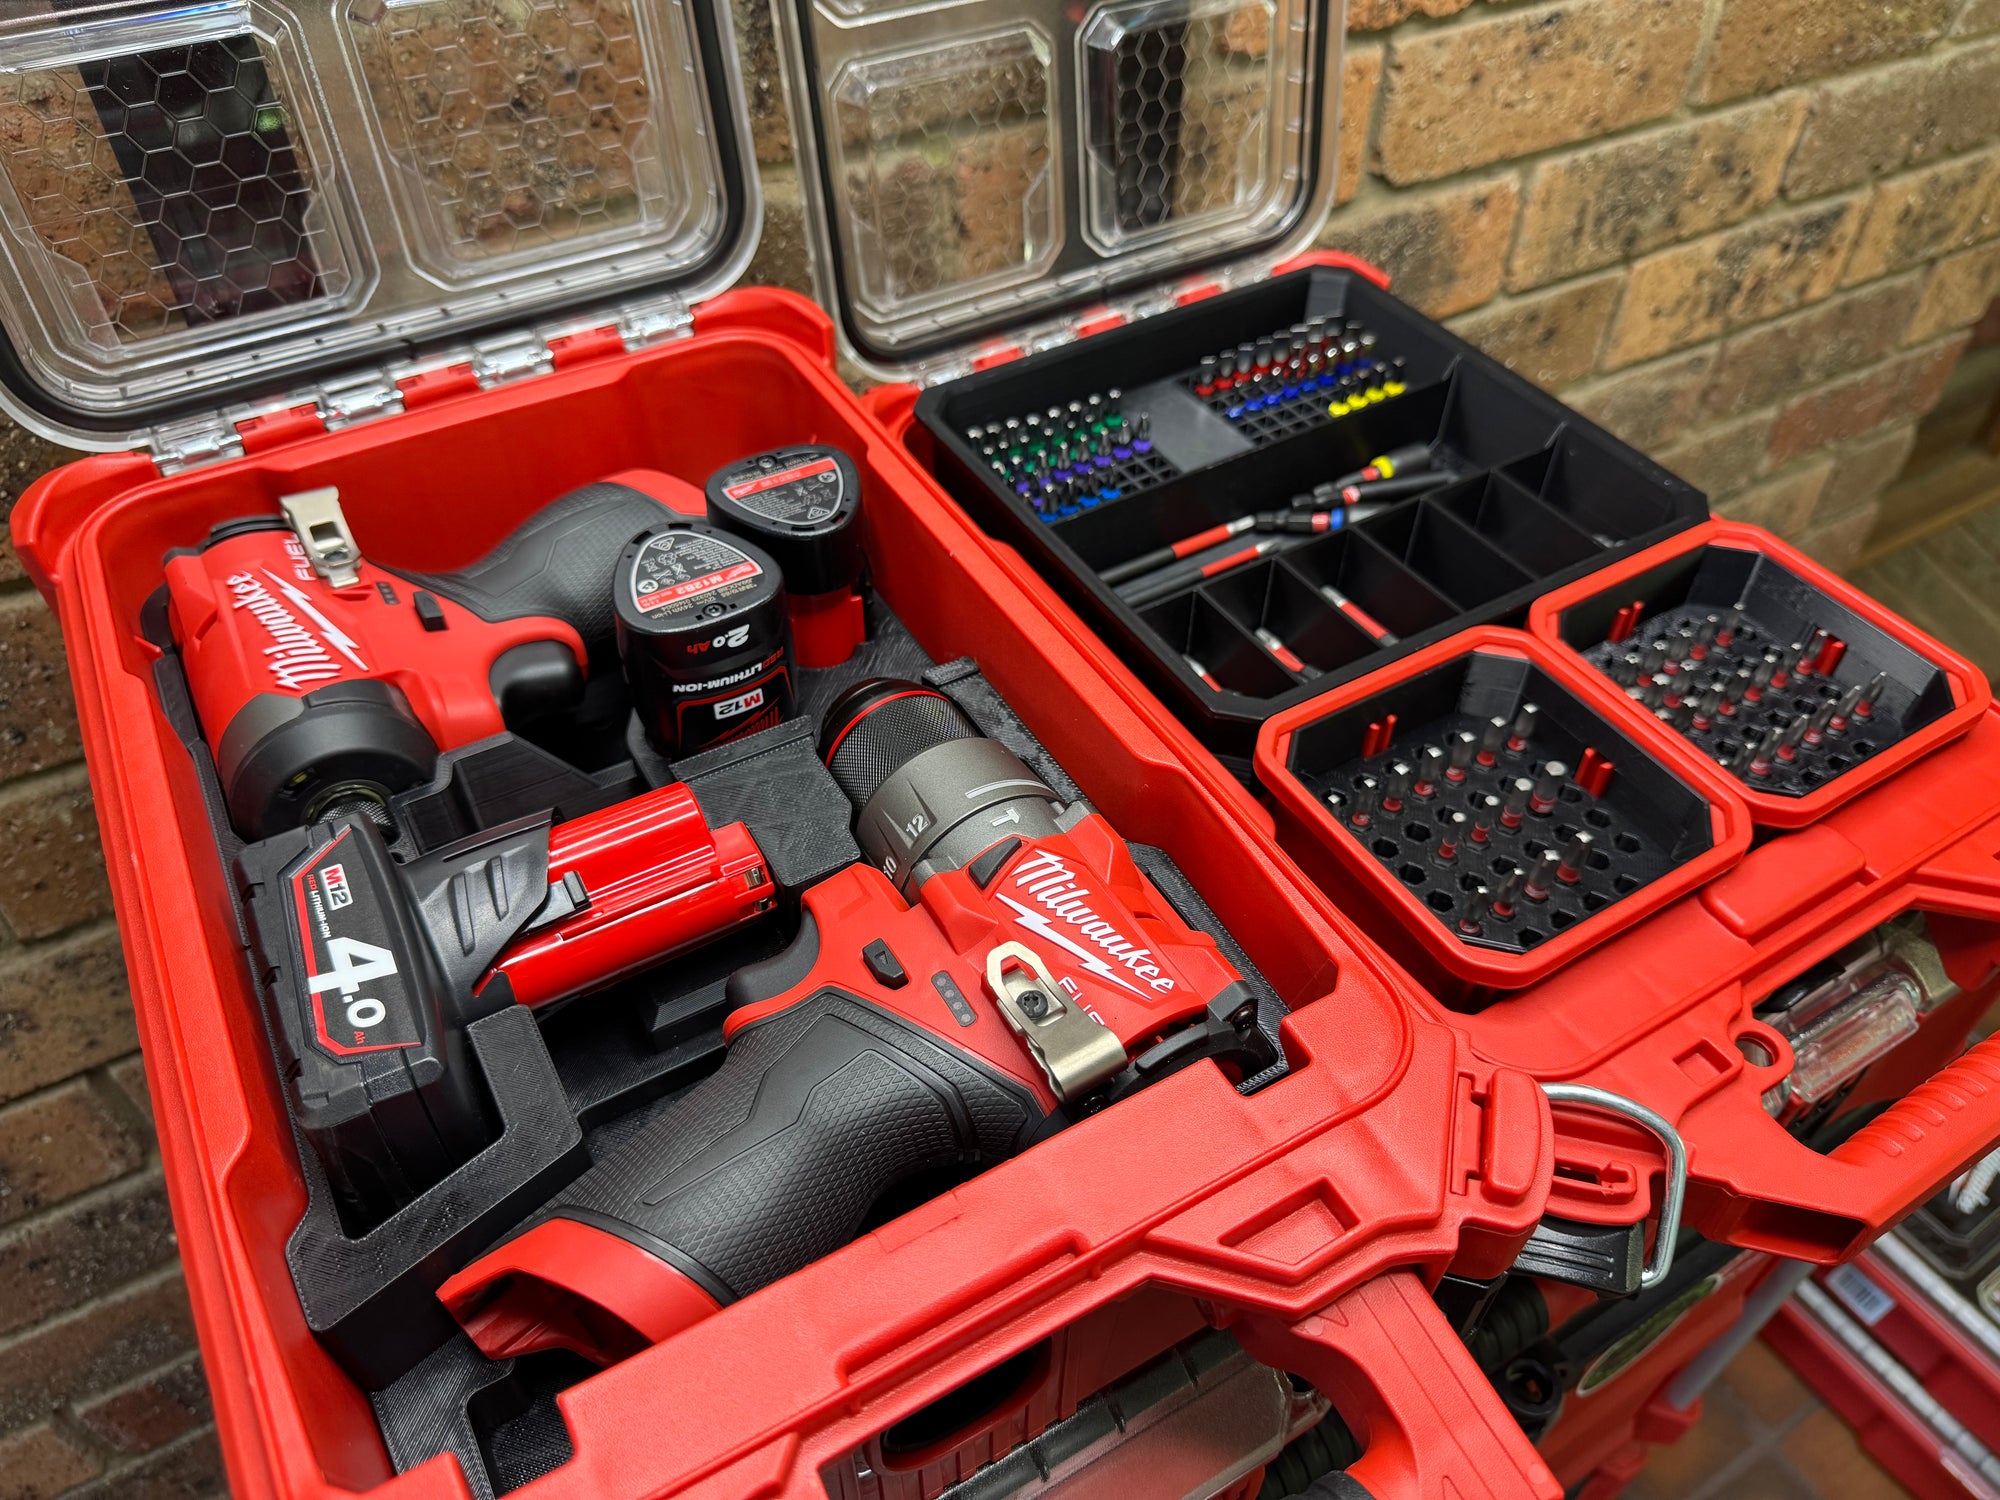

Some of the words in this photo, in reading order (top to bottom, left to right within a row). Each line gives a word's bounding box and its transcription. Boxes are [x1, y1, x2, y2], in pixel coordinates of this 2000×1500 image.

[283, 533, 316, 581] FUEL
[226, 570, 342, 690] Milwaukee
[687, 640, 711, 654] Ah
[712, 624, 750, 648] 2.0
[719, 692, 761, 715] M12
[906, 813, 929, 837] 12
[325, 866, 350, 906] M12
[1012, 850, 1175, 994] Milwaukee
[308, 937, 399, 1028] 4.0
[354, 1030, 366, 1045] Ah
